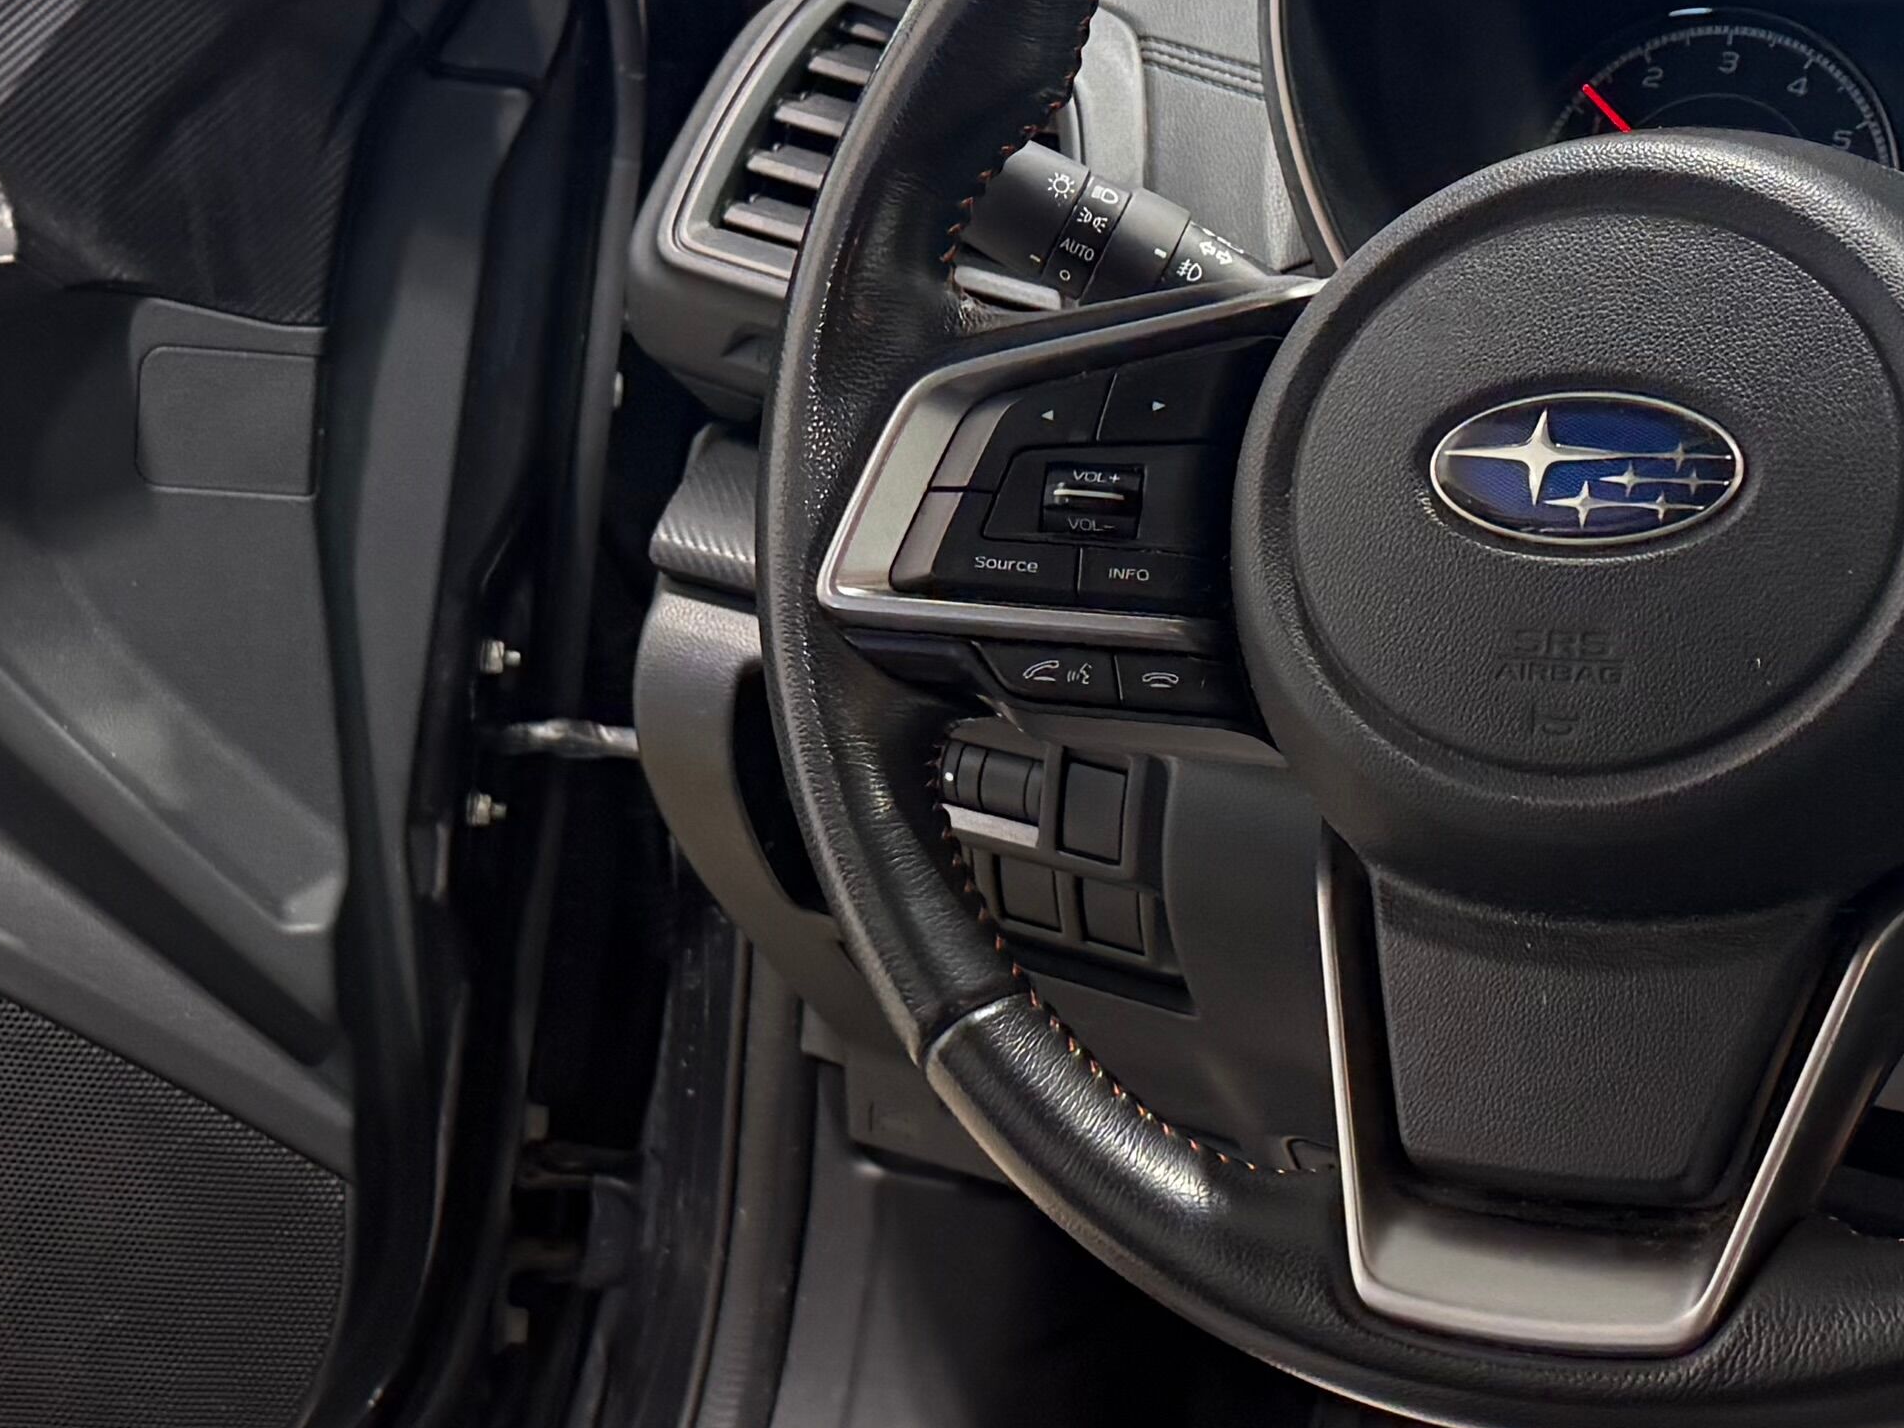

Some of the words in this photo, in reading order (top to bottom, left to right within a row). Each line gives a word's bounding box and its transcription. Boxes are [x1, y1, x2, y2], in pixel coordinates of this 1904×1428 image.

[1718, 51, 1739, 73] 3
[1642, 67, 1664, 88] 2
[1787, 77, 1808, 96] 4
[1832, 130, 1852, 150] 5
[1060, 238, 1095, 262] AUTO
[1108, 567, 1150, 582] INFO
[1514, 629, 1612, 655] SRS
[1495, 662, 1622, 683] AIRBAG
